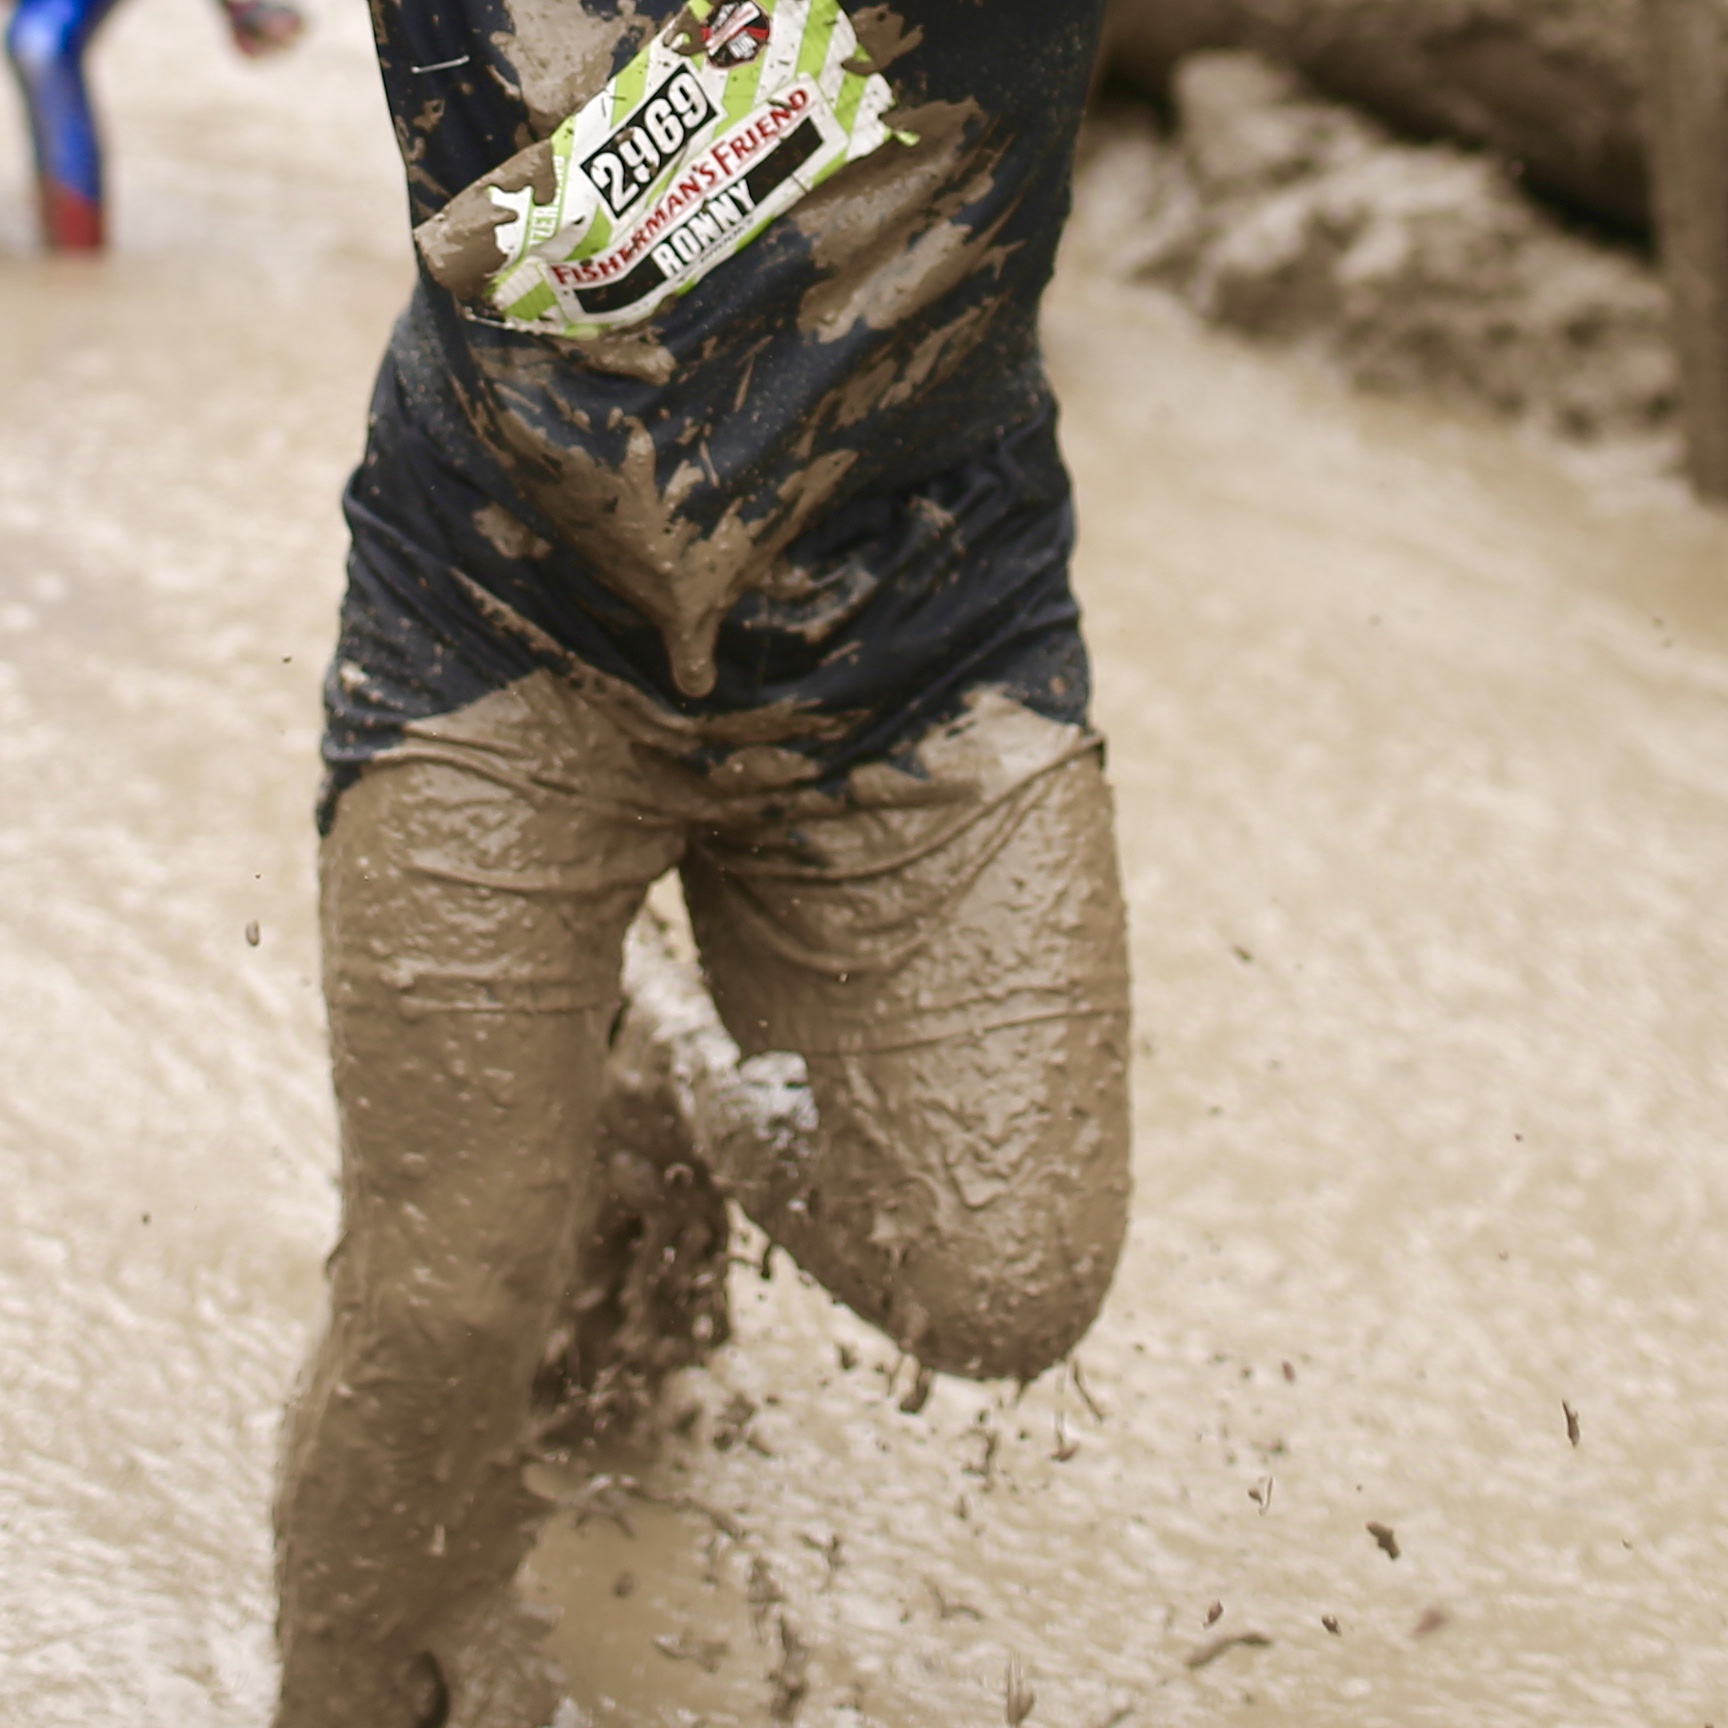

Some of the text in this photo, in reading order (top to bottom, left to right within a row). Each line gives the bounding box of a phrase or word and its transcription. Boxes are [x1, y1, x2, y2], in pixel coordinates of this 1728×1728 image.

[550, 161, 719, 285] FISHERMAN'S
[711, 88, 809, 176] FRIEND
[590, 72, 708, 213] 2969
[650, 179, 757, 278] RONNY
